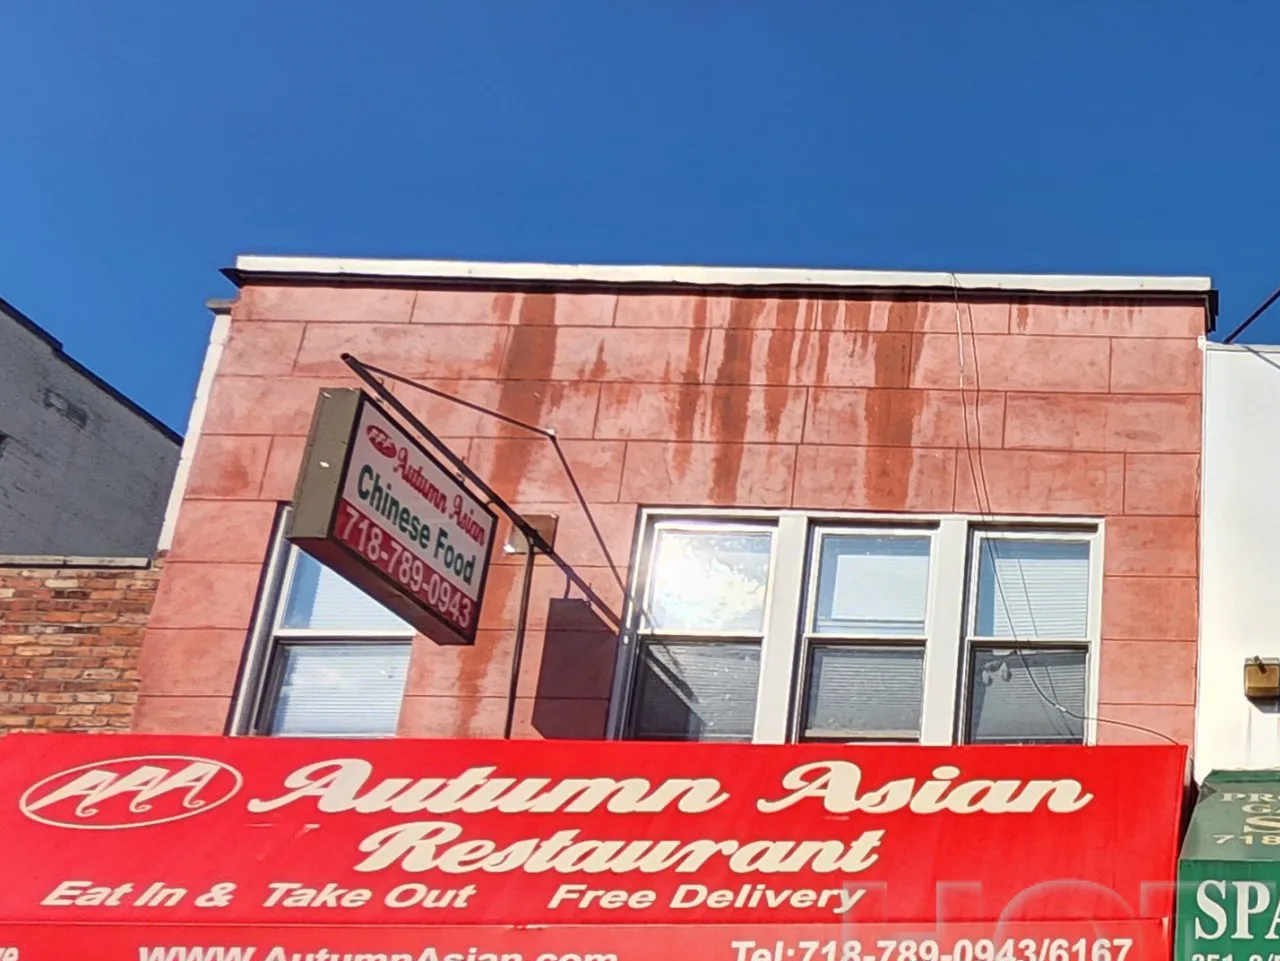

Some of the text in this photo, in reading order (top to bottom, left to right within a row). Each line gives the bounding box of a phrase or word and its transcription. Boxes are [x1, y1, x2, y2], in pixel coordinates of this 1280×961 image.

[357, 464, 477, 585] Chinese Food
[393, 447, 486, 547] Autumn Asian
[343, 507, 473, 629] 718-789-0943
[247, 758, 1094, 815] Autumn Asian
[353, 821, 885, 874] Restaurant
[40, 880, 476, 909] Eat In & Take Out
[547, 883, 867, 914] Free Delivery
